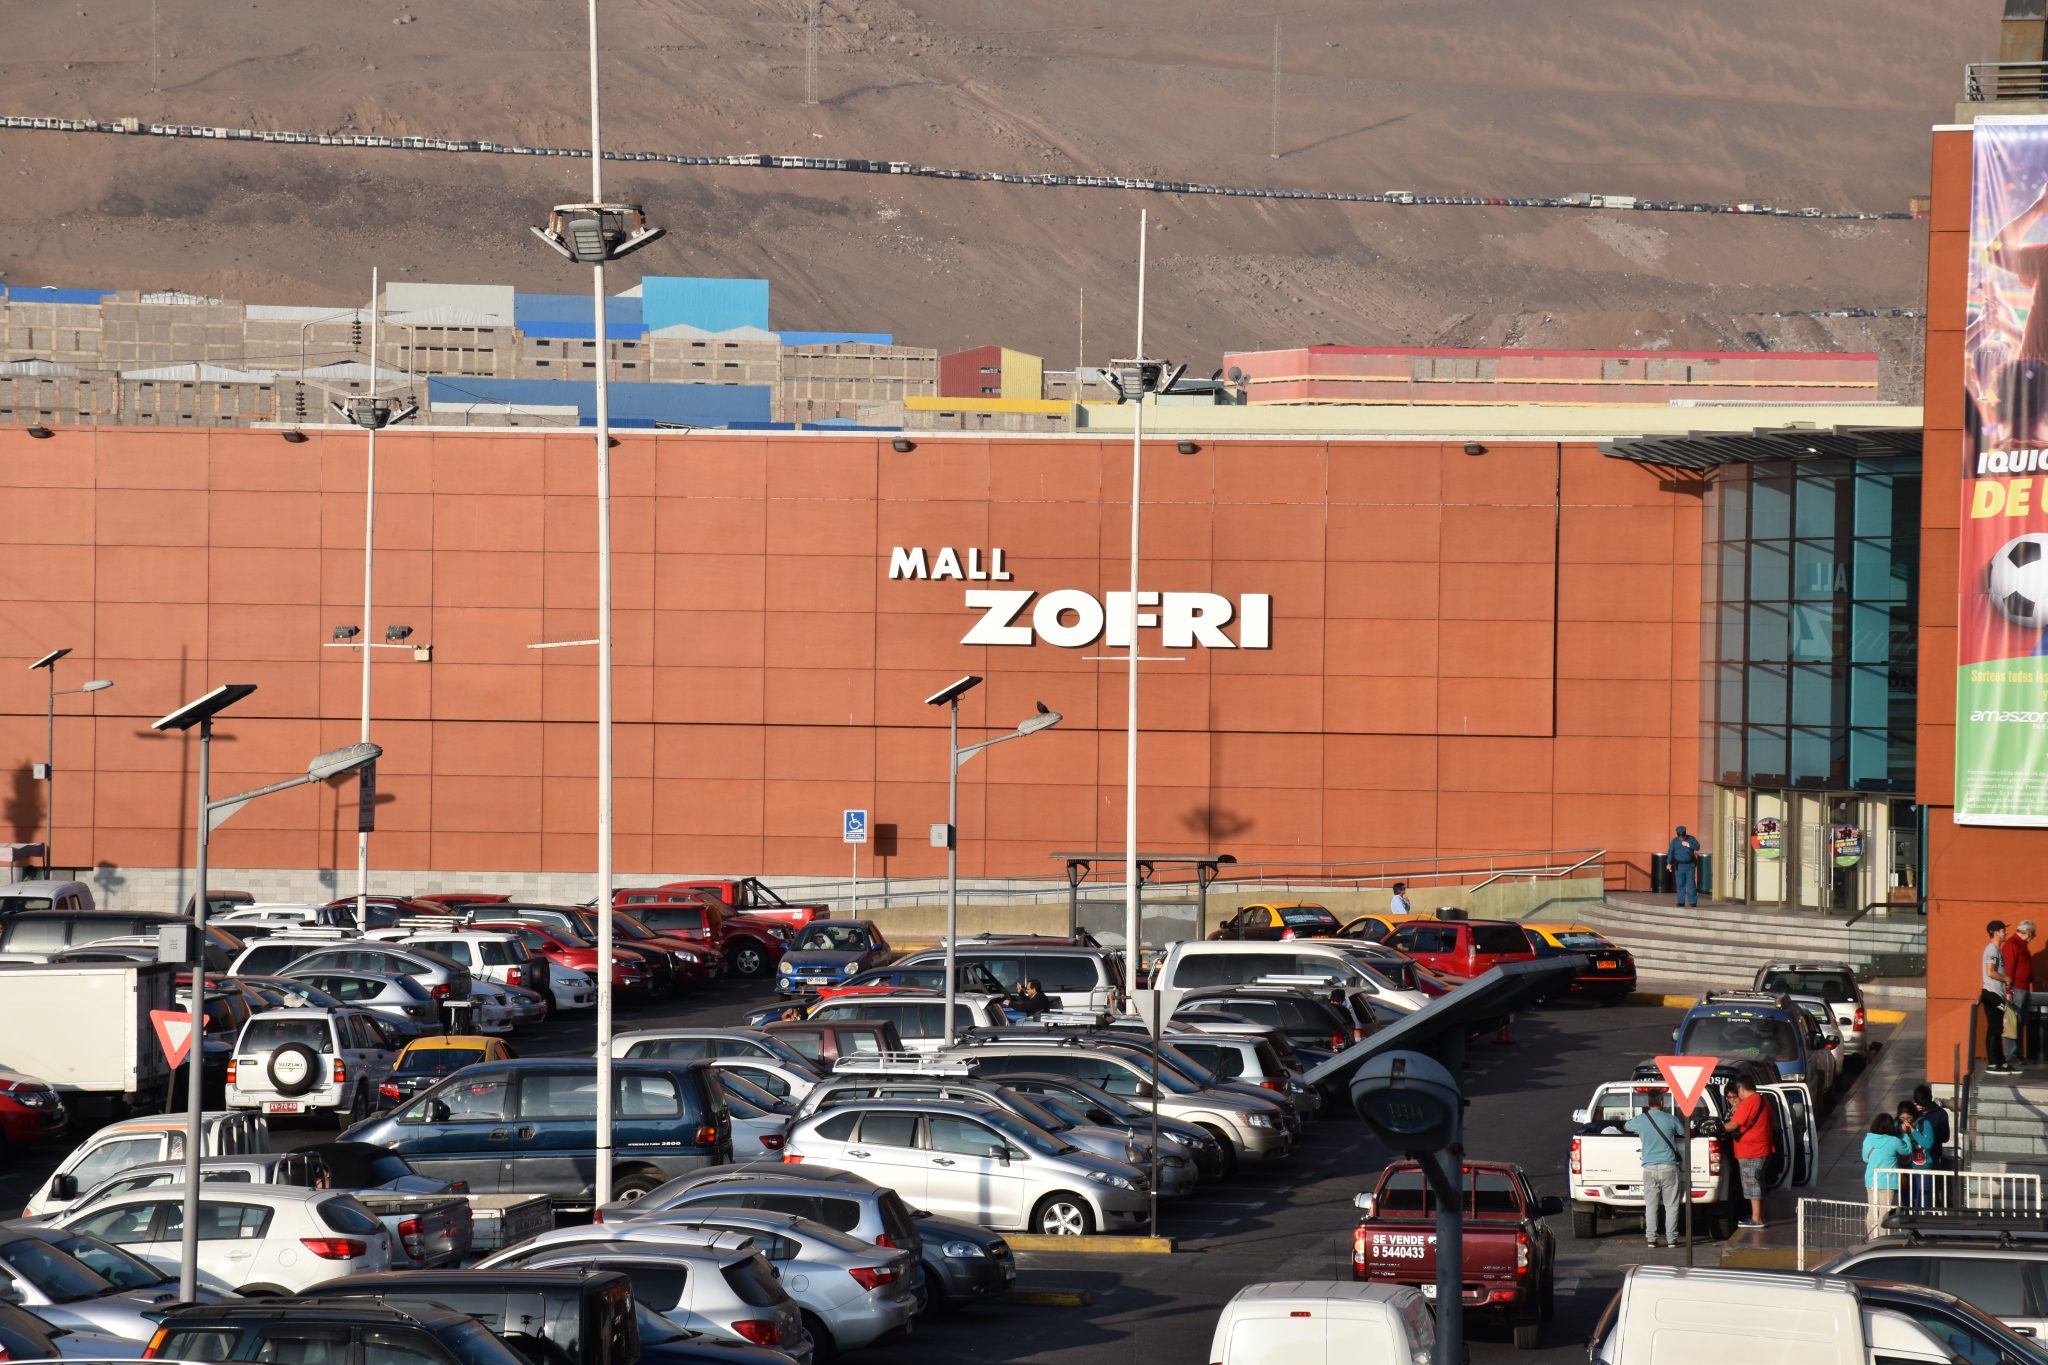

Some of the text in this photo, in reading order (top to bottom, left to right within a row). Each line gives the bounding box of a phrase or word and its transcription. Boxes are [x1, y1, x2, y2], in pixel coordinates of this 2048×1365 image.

[1970, 478, 2033, 519] DE
[888, 546, 1011, 580] MALL
[959, 589, 1270, 649] ZOFRI
[1372, 1245, 1425, 1259] 9 5440433
[1373, 1234, 1425, 1245] SE VENDE
